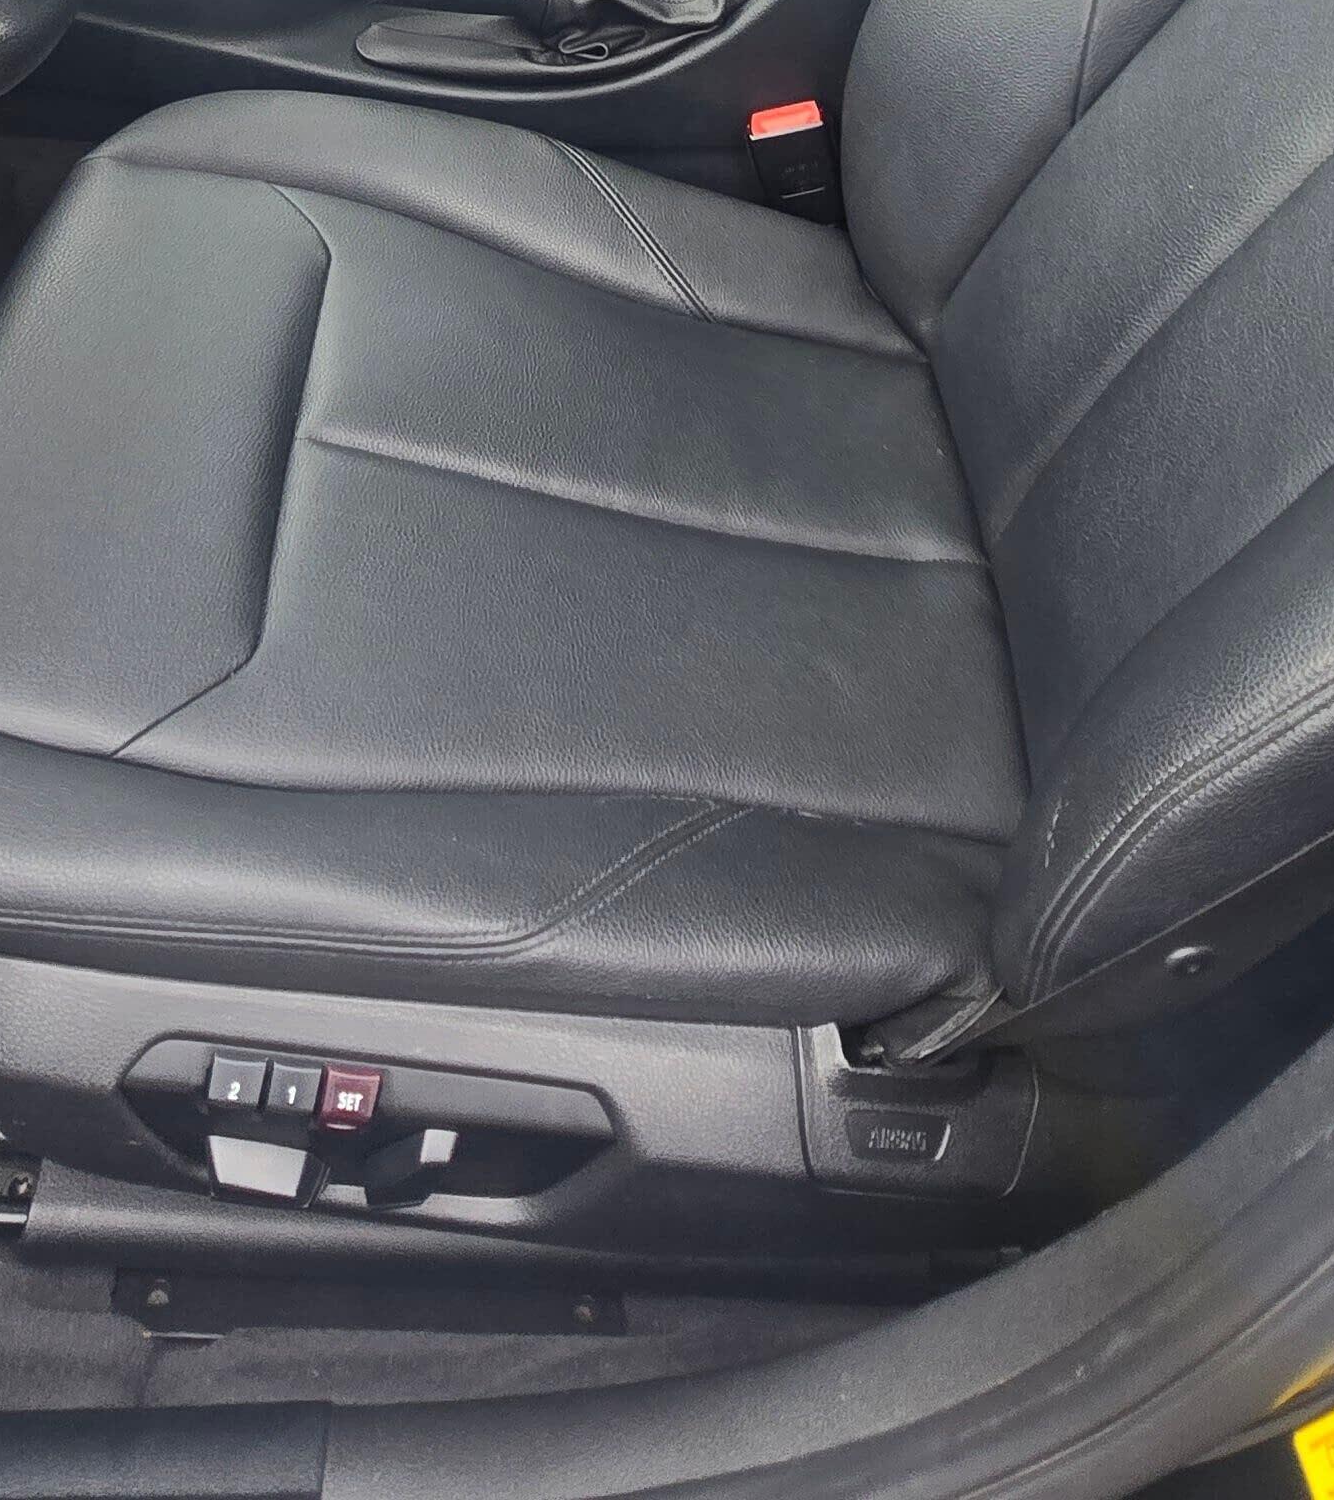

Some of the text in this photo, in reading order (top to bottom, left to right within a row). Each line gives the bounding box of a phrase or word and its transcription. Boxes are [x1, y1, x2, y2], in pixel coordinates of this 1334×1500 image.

[227, 1081, 241, 1100] 2
[287, 1086, 297, 1104] 1
[337, 1091, 364, 1112] SET
